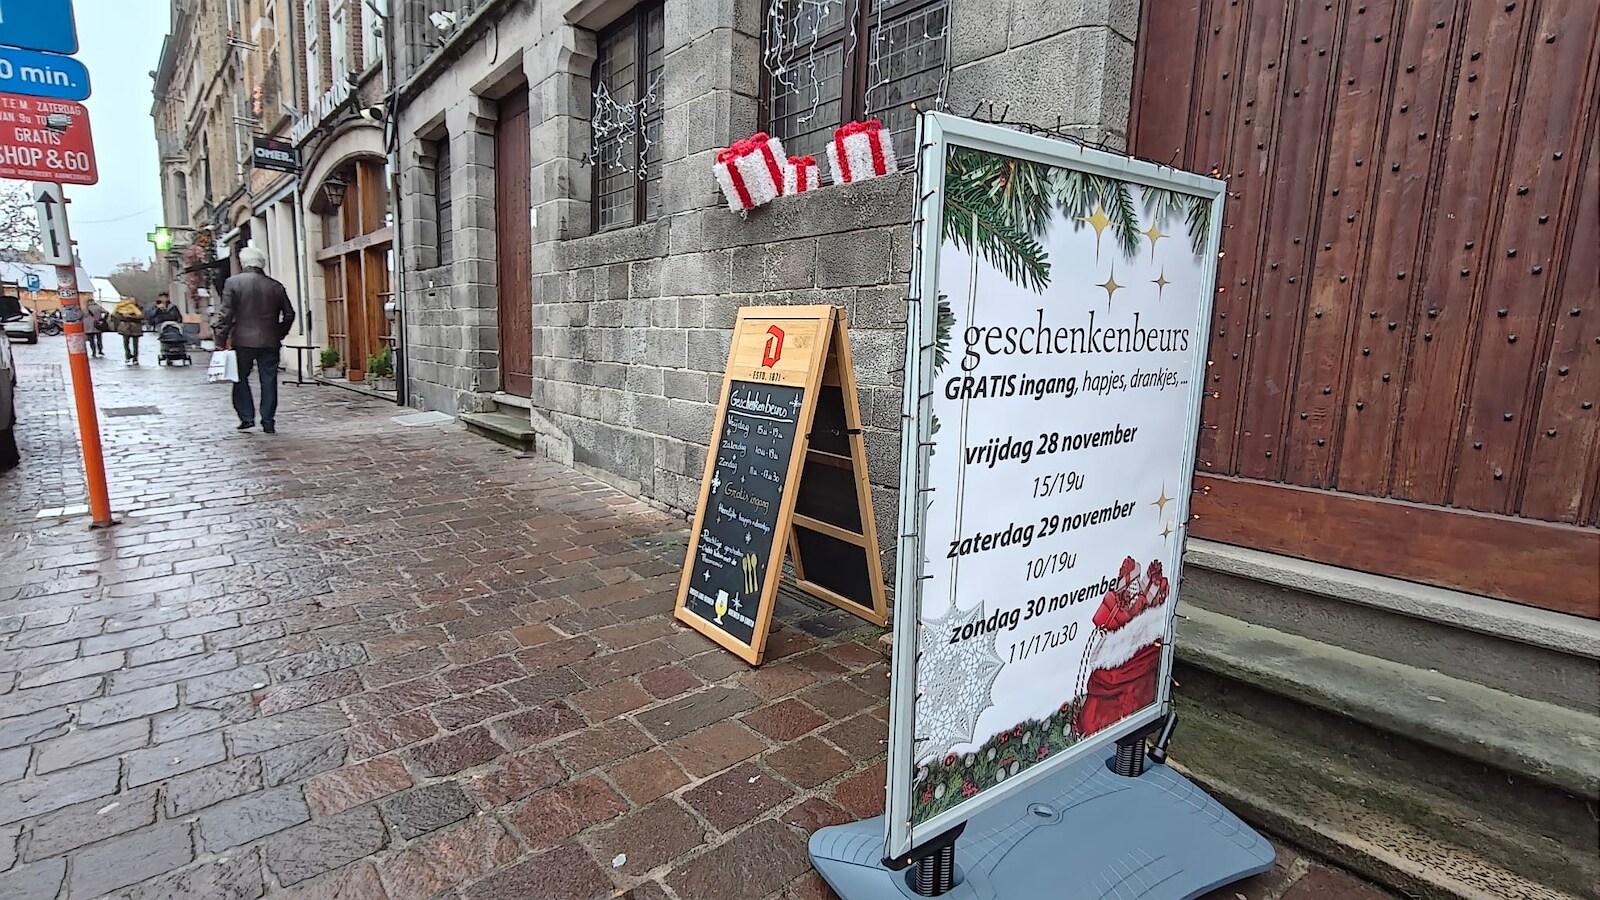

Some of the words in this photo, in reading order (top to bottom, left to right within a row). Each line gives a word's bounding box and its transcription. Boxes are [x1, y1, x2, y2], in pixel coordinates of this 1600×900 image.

[20, 66, 77, 88] min.
[36, 101, 81, 115] ZATERDAG
[14, 127, 61, 146] GRATIS
[961, 308, 1189, 371] geschenkenbeurs
[768, 372, 782, 382] 1871
[945, 374, 1017, 400] GRATIS
[1019, 373, 1078, 401] ingang,
[1082, 369, 1127, 396] hapjes,
[965, 436, 1033, 469] vrijdag
[1036, 432, 1059, 456] 28
[1061, 423, 1138, 452] november
[718, 456, 739, 475] Zondag
[1033, 471, 1084, 498] 15/19u
[946, 523, 1035, 559] zaterdag
[1037, 514, 1060, 538] 29
[1061, 500, 1136, 533] november
[1026, 551, 1077, 581] 10/19u
[949, 606, 1021, 645] zondag
[1023, 598, 1046, 620] 30
[1048, 575, 1123, 613] november
[1009, 621, 1078, 664] 11/17u30
